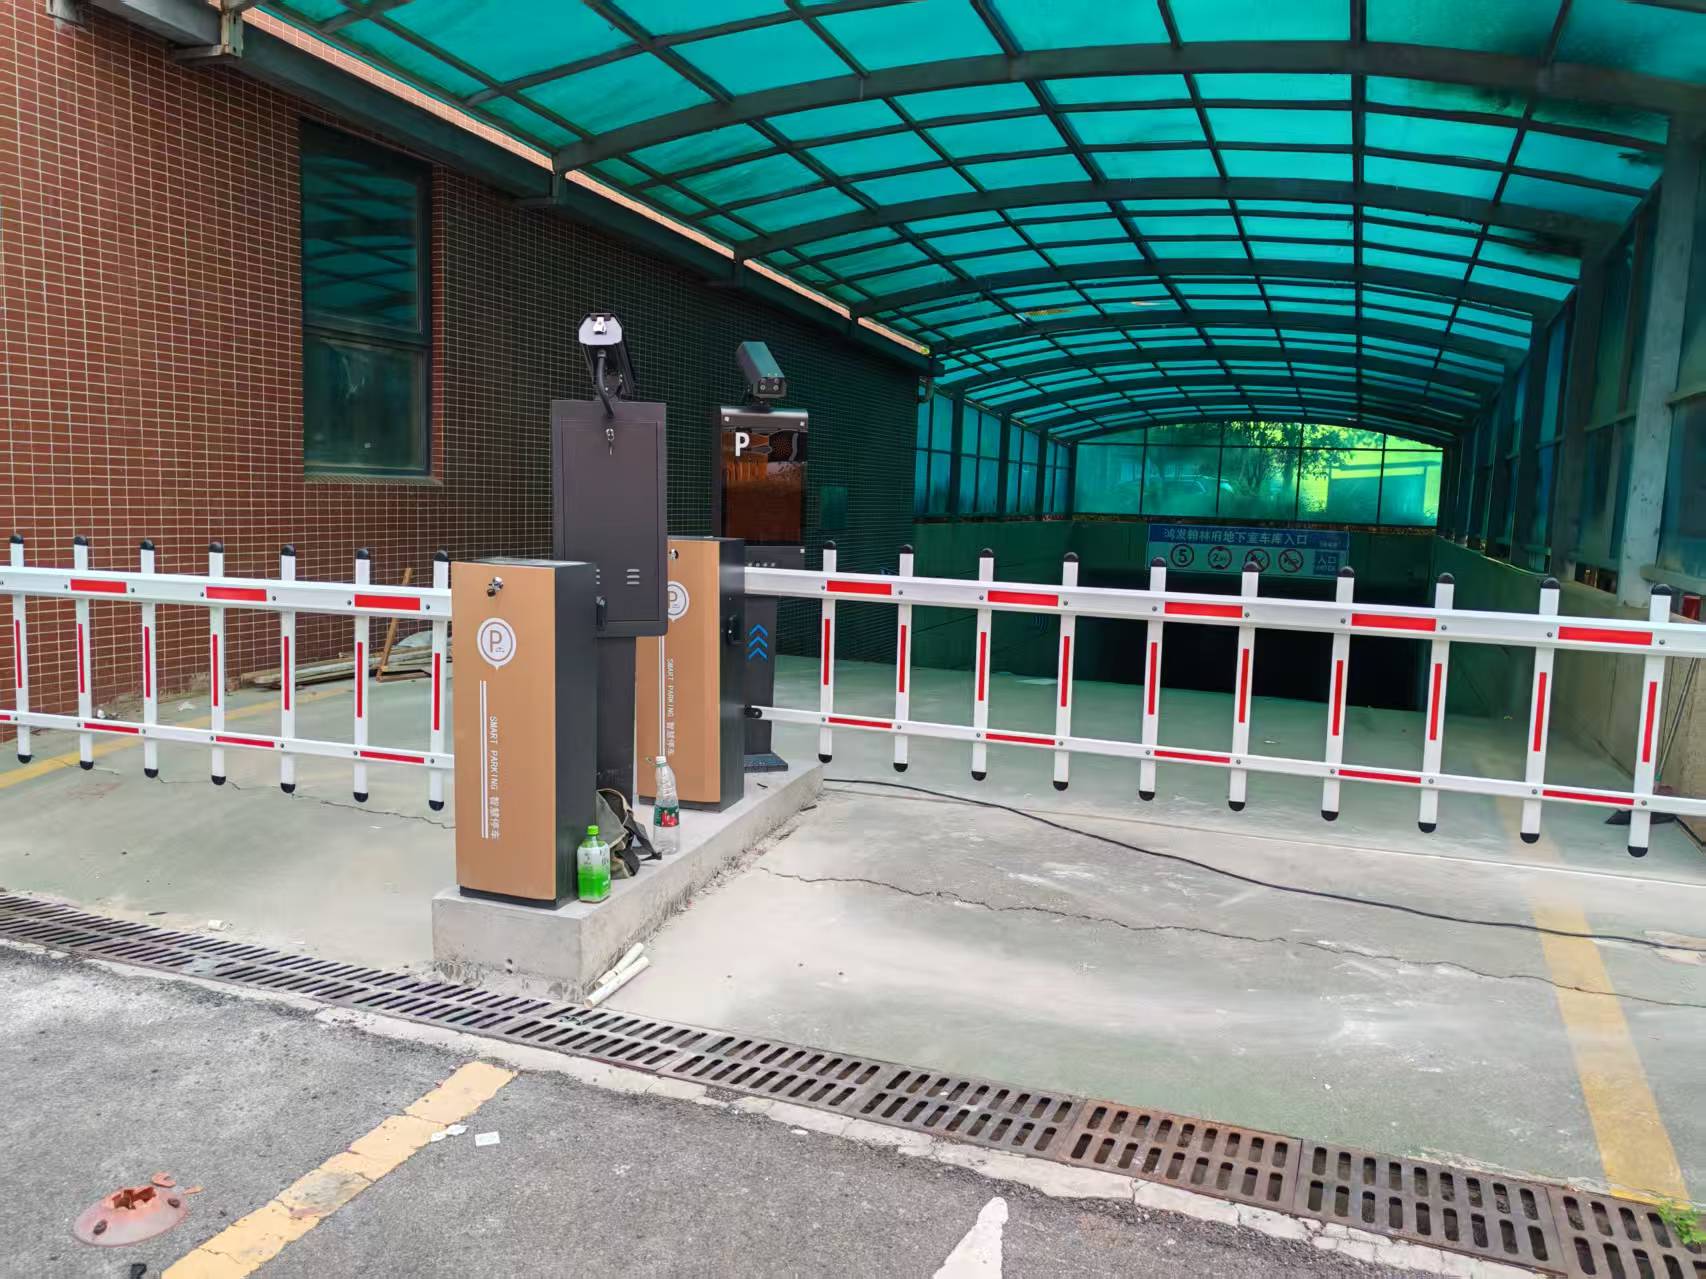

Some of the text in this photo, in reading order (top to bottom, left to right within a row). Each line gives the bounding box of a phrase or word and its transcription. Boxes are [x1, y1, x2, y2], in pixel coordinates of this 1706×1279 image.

[735, 432, 750, 457] P
[1178, 549, 1187, 563] 5
[489, 630, 502, 653] P
[667, 685, 675, 717] PARKING
[489, 716, 498, 745] SMART
[490, 750, 499, 790] PARKING
